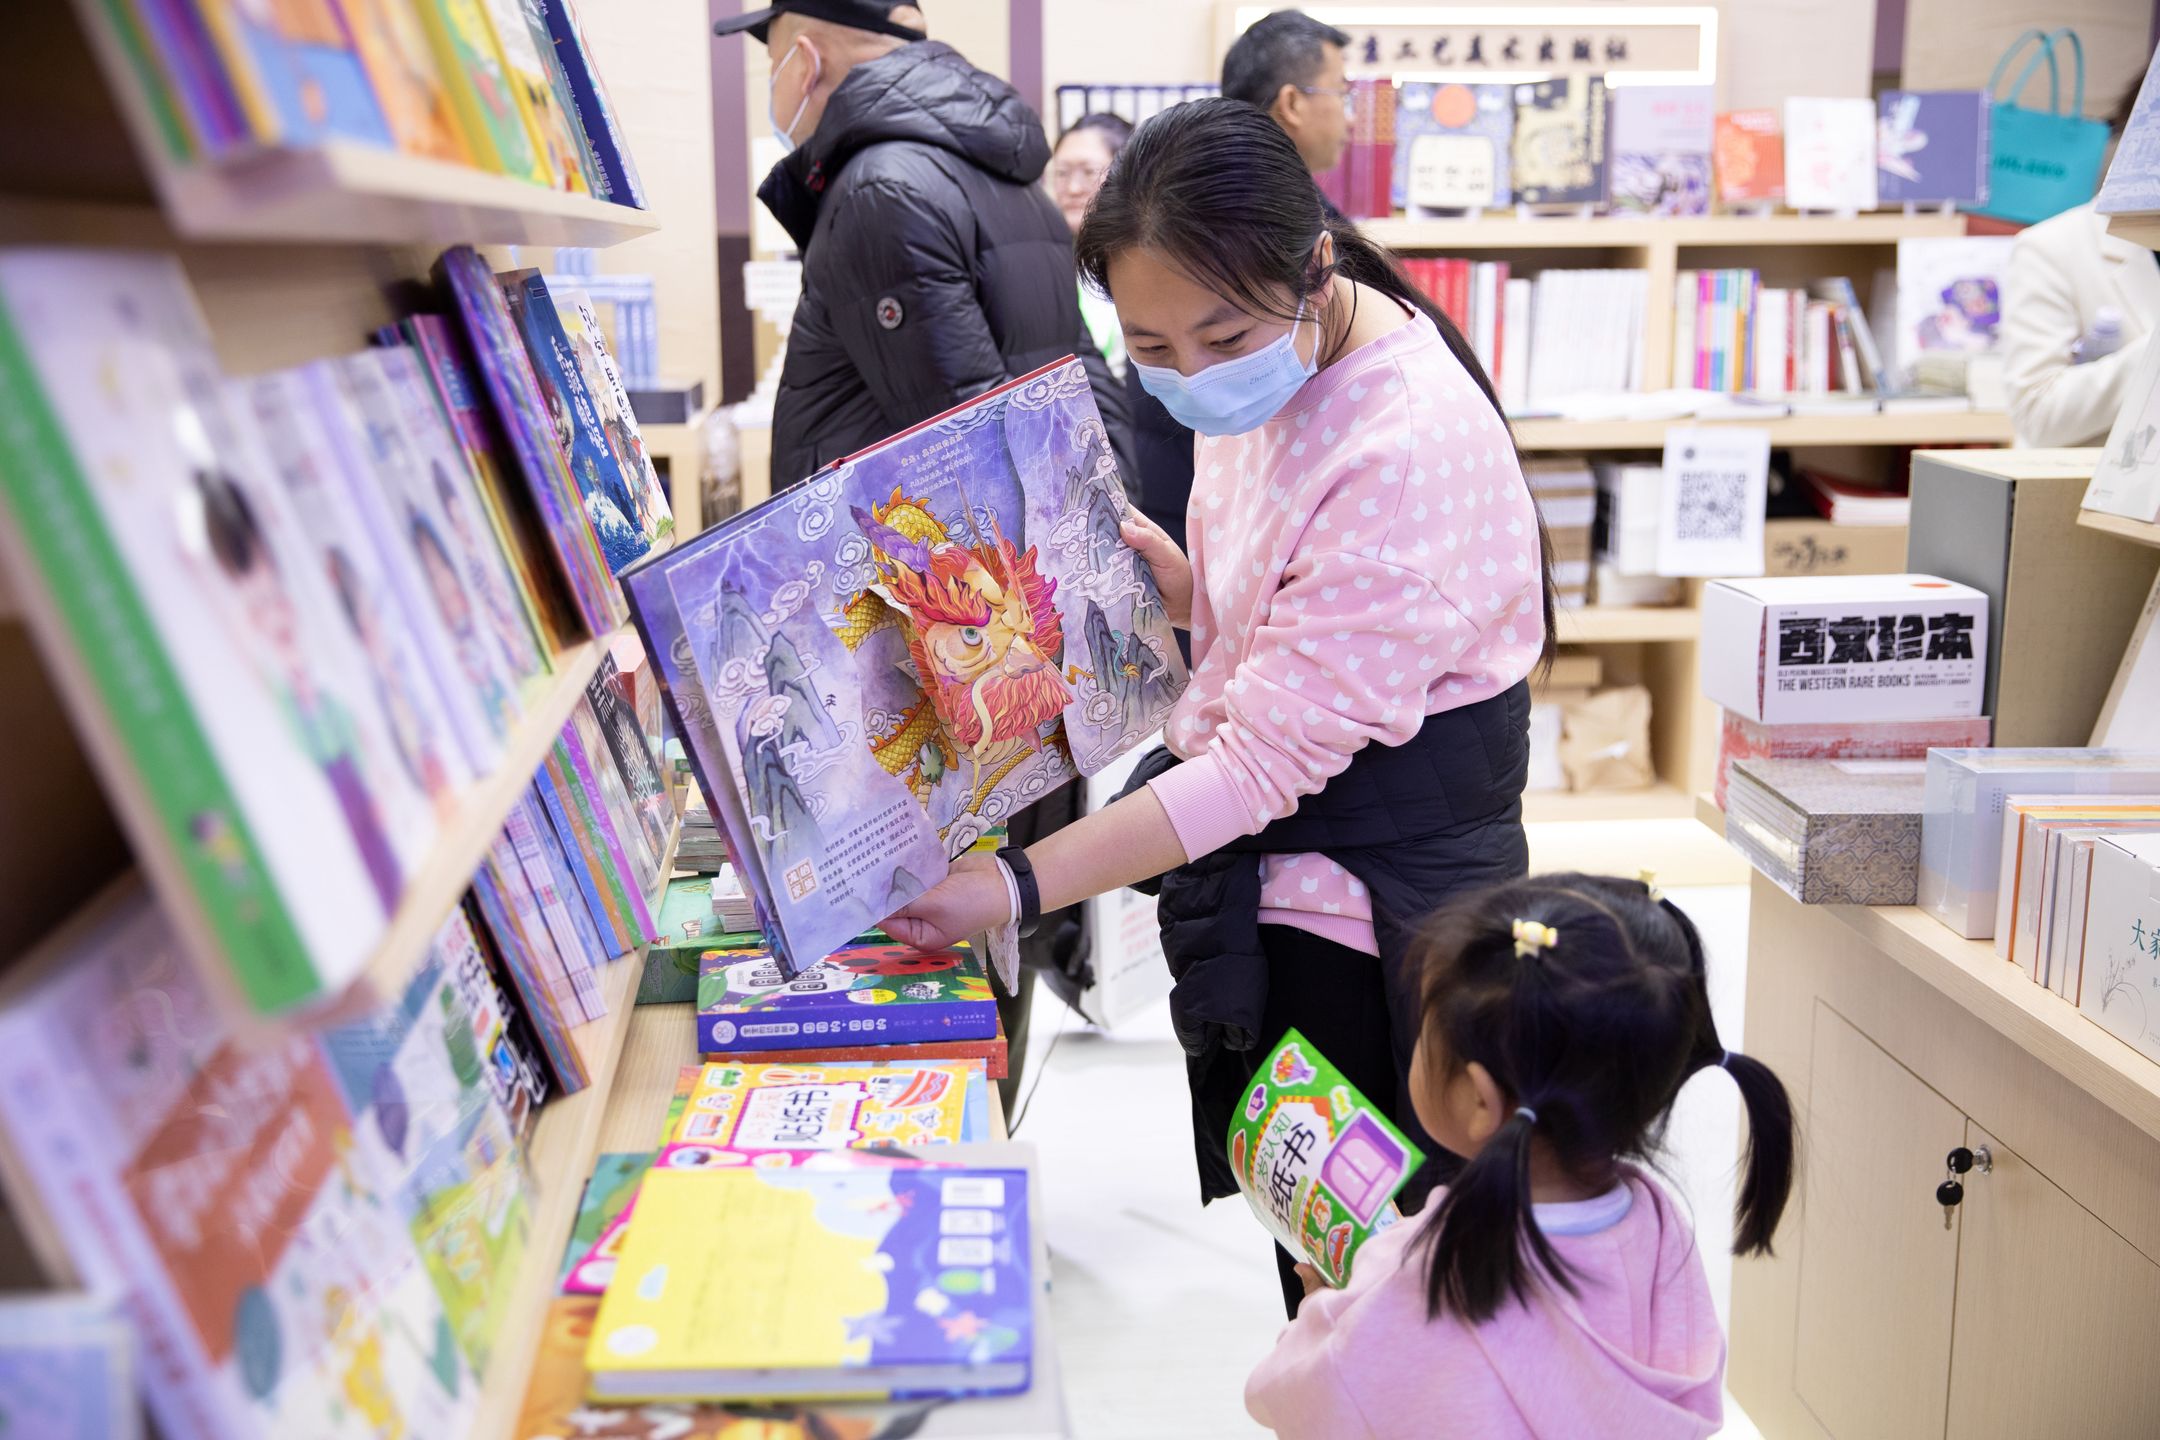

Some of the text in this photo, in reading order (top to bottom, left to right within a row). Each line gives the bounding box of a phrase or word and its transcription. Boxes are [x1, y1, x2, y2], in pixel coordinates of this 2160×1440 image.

[1344, 33, 1629, 67] 京工艺美术出版社
[1779, 613, 1974, 666] 西文珍本
[1778, 674, 1912, 691] THE WESTERN RARE BOOKS
